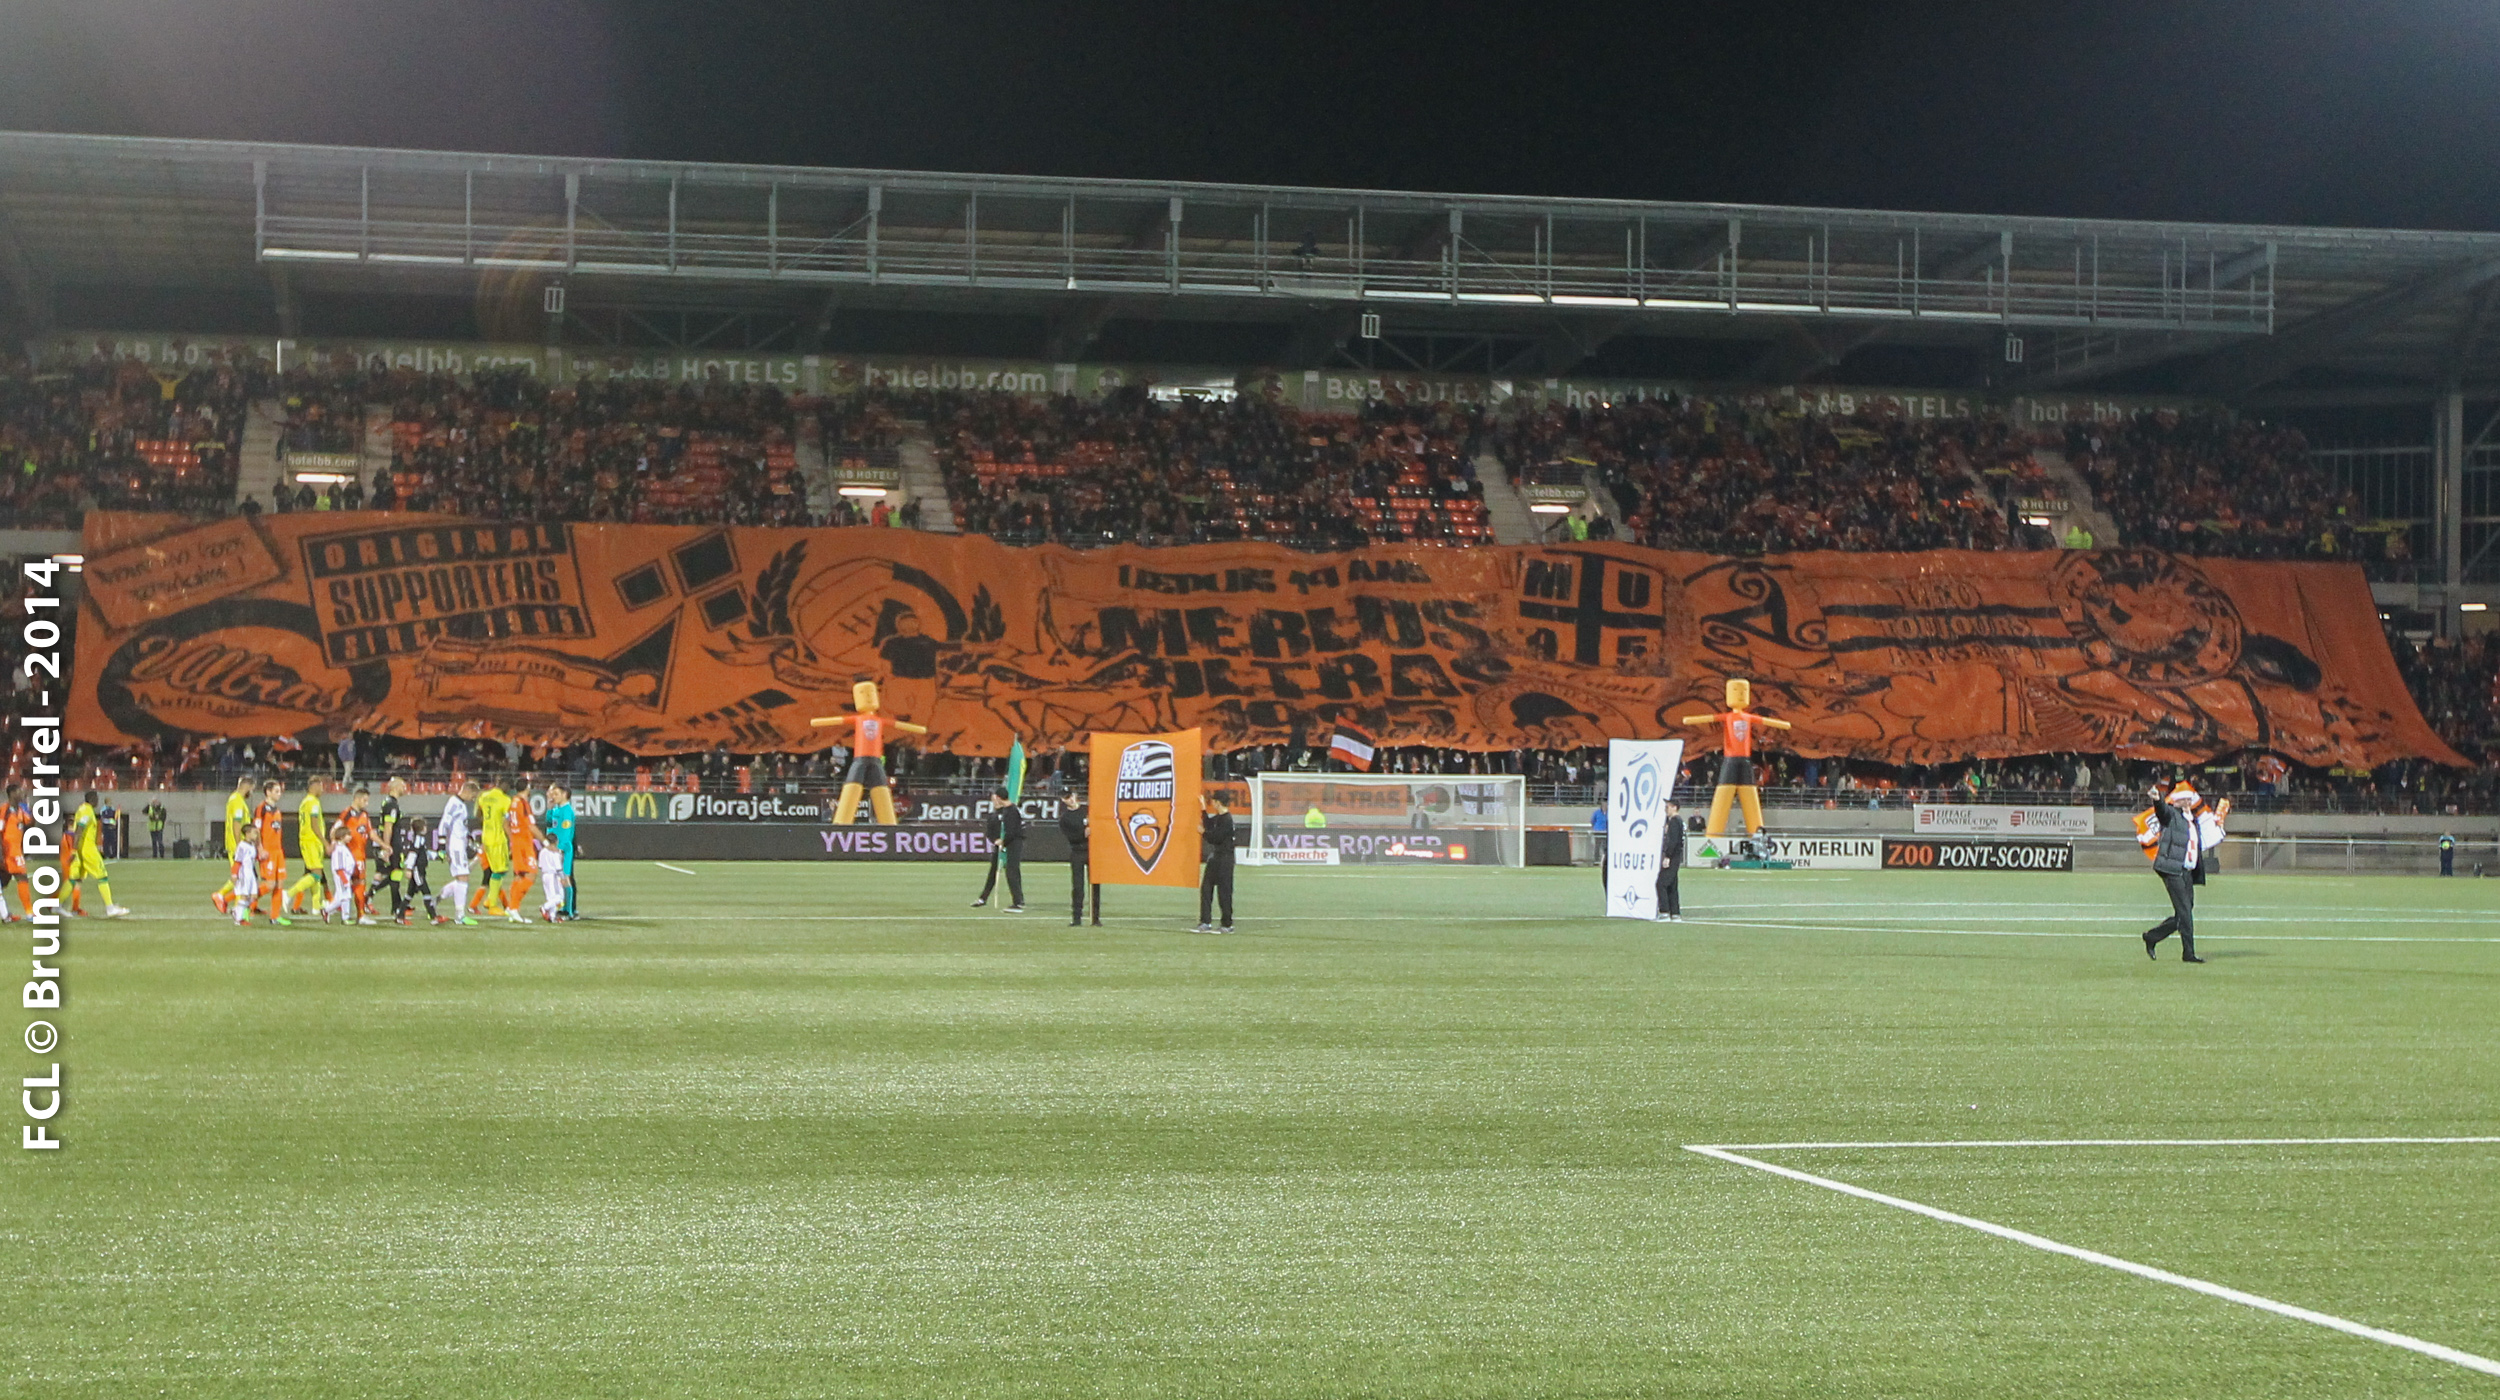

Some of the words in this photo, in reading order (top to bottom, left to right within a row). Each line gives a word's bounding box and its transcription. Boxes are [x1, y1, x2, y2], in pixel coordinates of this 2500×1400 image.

[325, 525, 552, 570] ORIGINAL
[329, 559, 562, 627] SUPPORTERS
[1098, 594, 1492, 660] MERLUS
[1119, 782, 1131, 799] FC
[1133, 781, 1172, 799] LORIENT
[696, 796, 819, 821] florajet.com
[918, 803, 968, 821] Jean
[1936, 809, 1972, 817] EIFFAGE
[2027, 811, 2061, 819] EIFFAGE
[1936, 817, 1999, 826] CONSTRUCTION
[2027, 818, 2088, 827] CONSTRUCTION
[820, 831, 888, 853] YVES
[1800, 841, 1875, 857] MERLIN
[1613, 852, 1646, 870] LIGUE
[1887, 844, 1935, 866] ZOO
[1938, 845, 2069, 869] PONT-SCORFF
